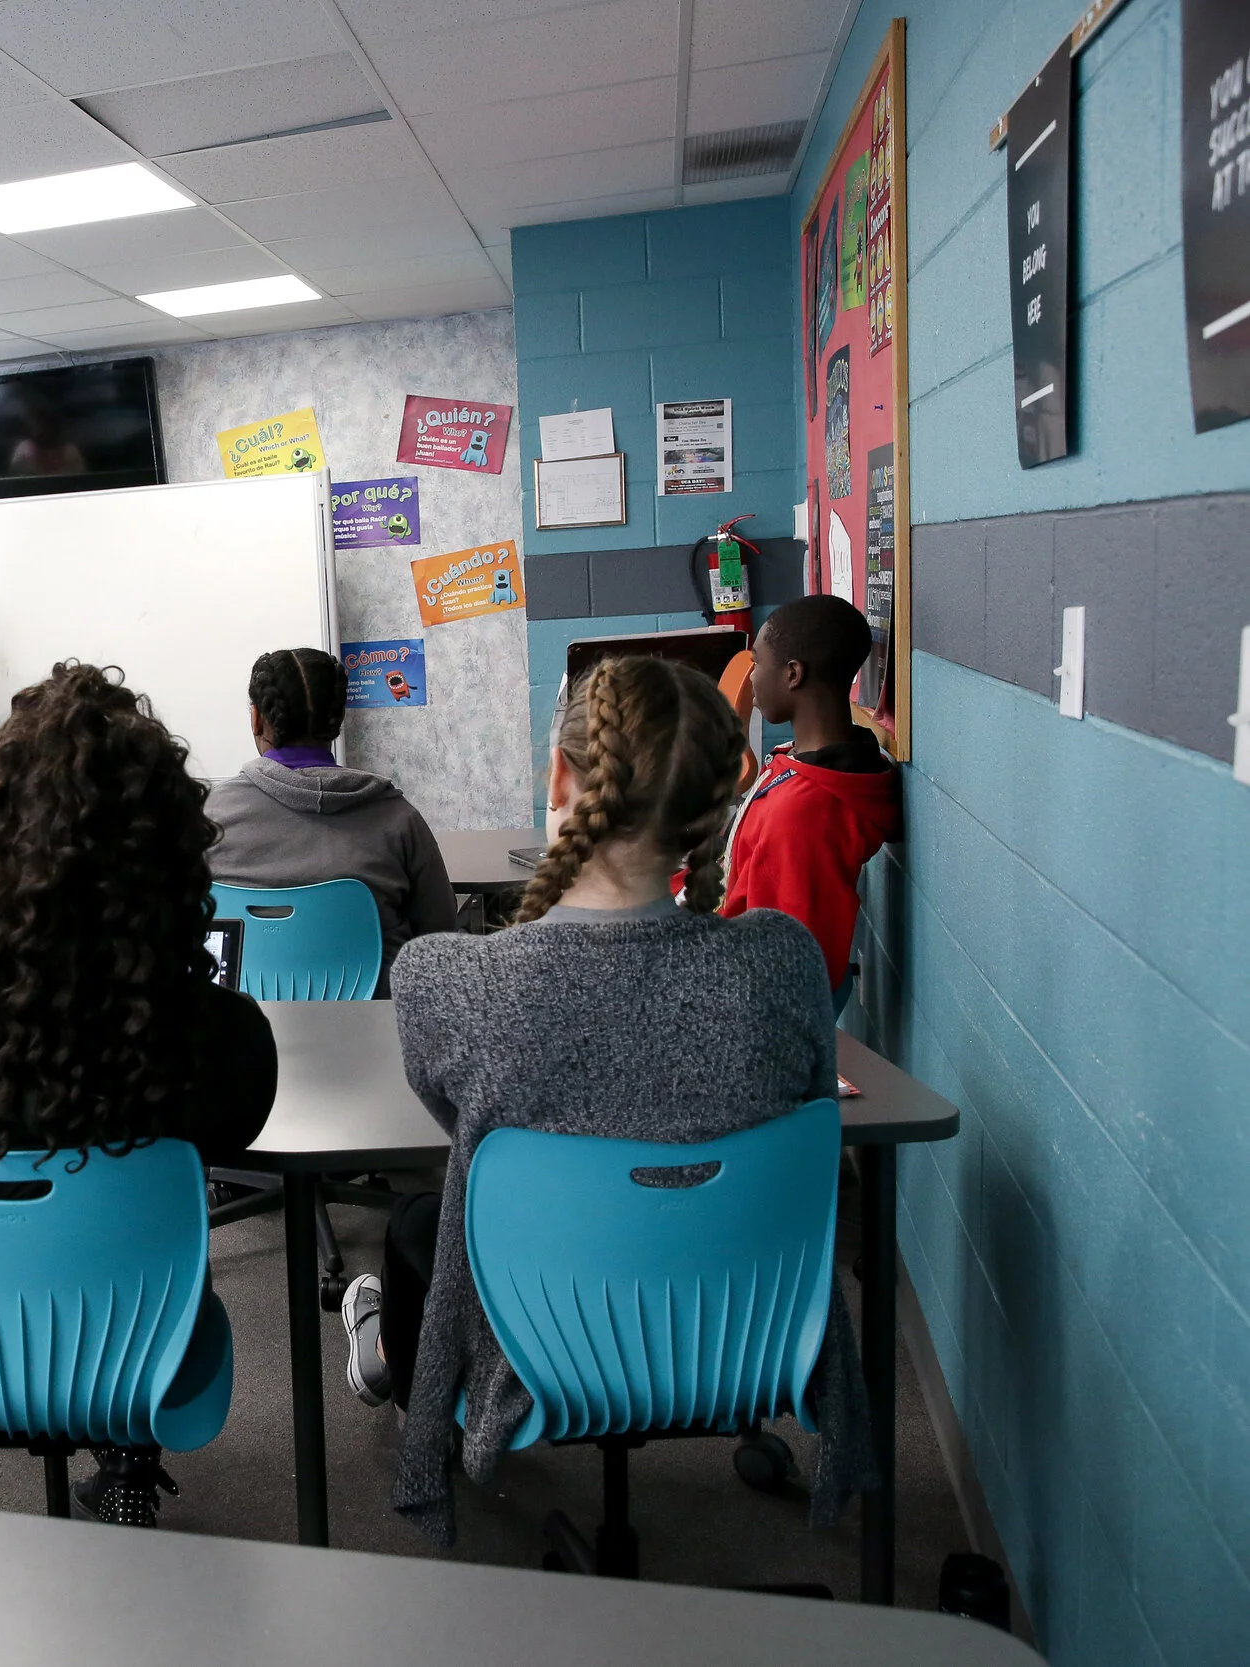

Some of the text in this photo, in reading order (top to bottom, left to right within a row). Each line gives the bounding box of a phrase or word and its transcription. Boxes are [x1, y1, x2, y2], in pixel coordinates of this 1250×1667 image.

[1210, 57, 1244, 121] YOU
[1212, 162, 1235, 212] AT
[1027, 200, 1040, 235] YOU
[1022, 243, 1047, 285] BELONG
[1027, 293, 1041, 327] HERE
[442, 426, 468, 438] Who?
[229, 422, 284, 463] ¿Cuál?
[258, 443, 280, 452] Which
[288, 434, 310, 444] What?
[416, 442, 462, 452] buen bailador?
[264, 454, 278, 462] baile
[234, 468, 256, 477] favorito
[264, 460, 280, 468] Raúl?
[362, 504, 382, 512] Why?
[356, 524, 374, 532] gusta
[456, 574, 485, 587] When?
[467, 584, 493, 594] practica
[440, 597, 460, 606] Juan?
[358, 668, 383, 676] How?
